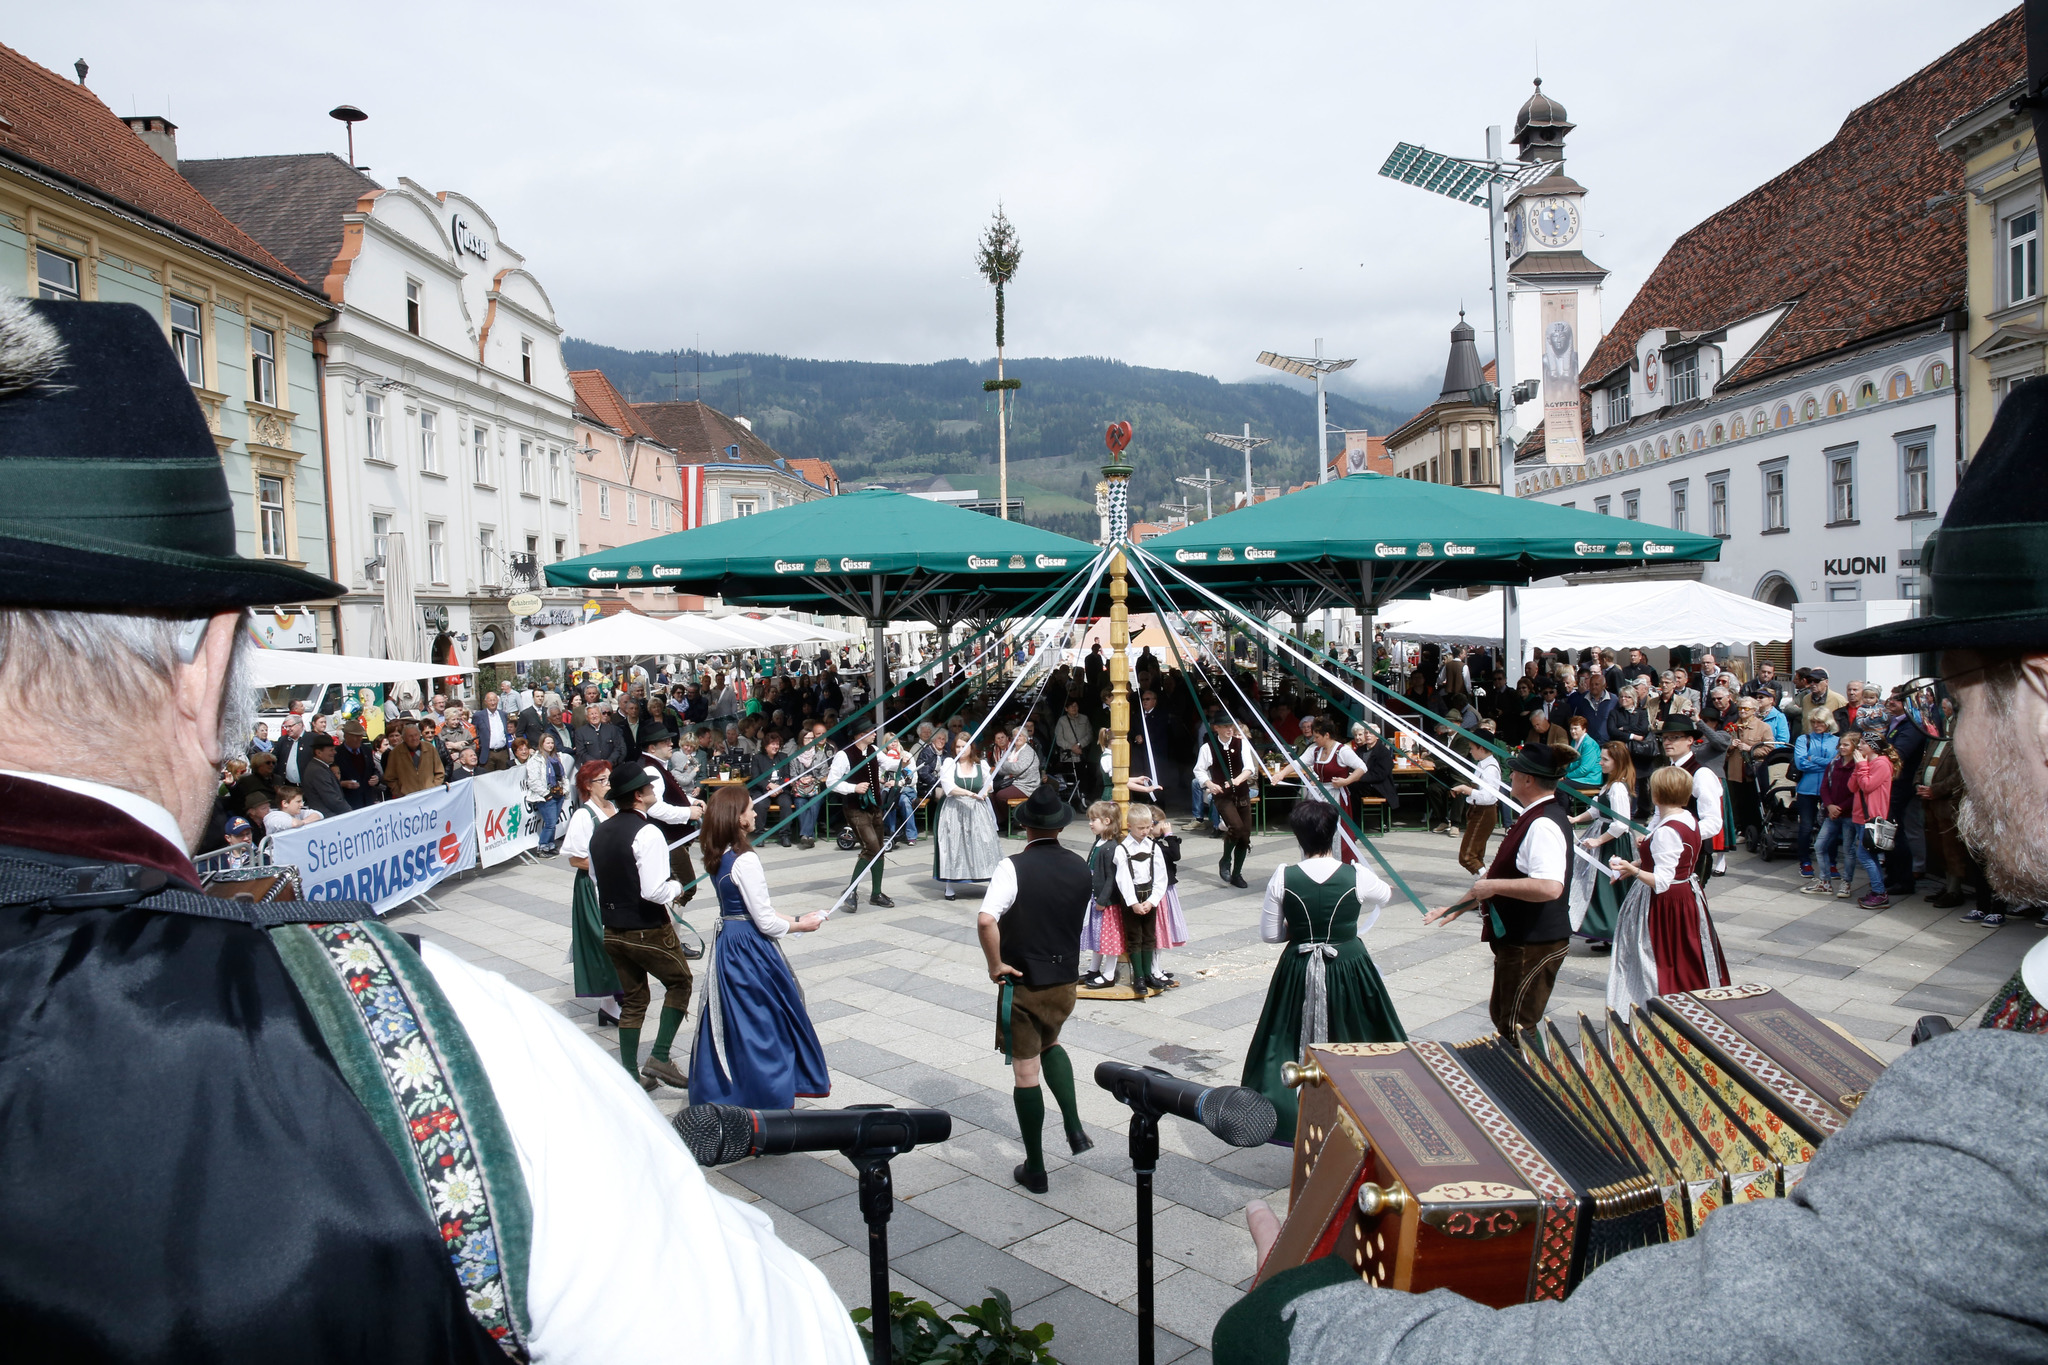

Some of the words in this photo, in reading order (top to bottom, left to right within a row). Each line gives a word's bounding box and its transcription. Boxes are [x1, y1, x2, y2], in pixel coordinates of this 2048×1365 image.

[1175, 549, 1207, 562] Gösser
[1244, 546, 1276, 560] Gösser
[1375, 543, 1407, 557] Gösser
[1443, 542, 1475, 556] Gösser
[1574, 541, 1606, 556] Gösser
[1642, 541, 1674, 555] Gösser
[774, 559, 804, 574] Gösser
[840, 557, 871, 572] Gösser
[967, 555, 998, 570] Gösser
[1035, 554, 1067, 568] Gösser
[1824, 556, 1886, 576] KUONI
[588, 567, 618, 581] Gösser
[652, 564, 682, 578] Gösser
[298, 633, 314, 644] Drei.
[484, 806, 507, 844] AK
[524, 816, 541, 836] für
[307, 806, 438, 873] Steiermärkische
